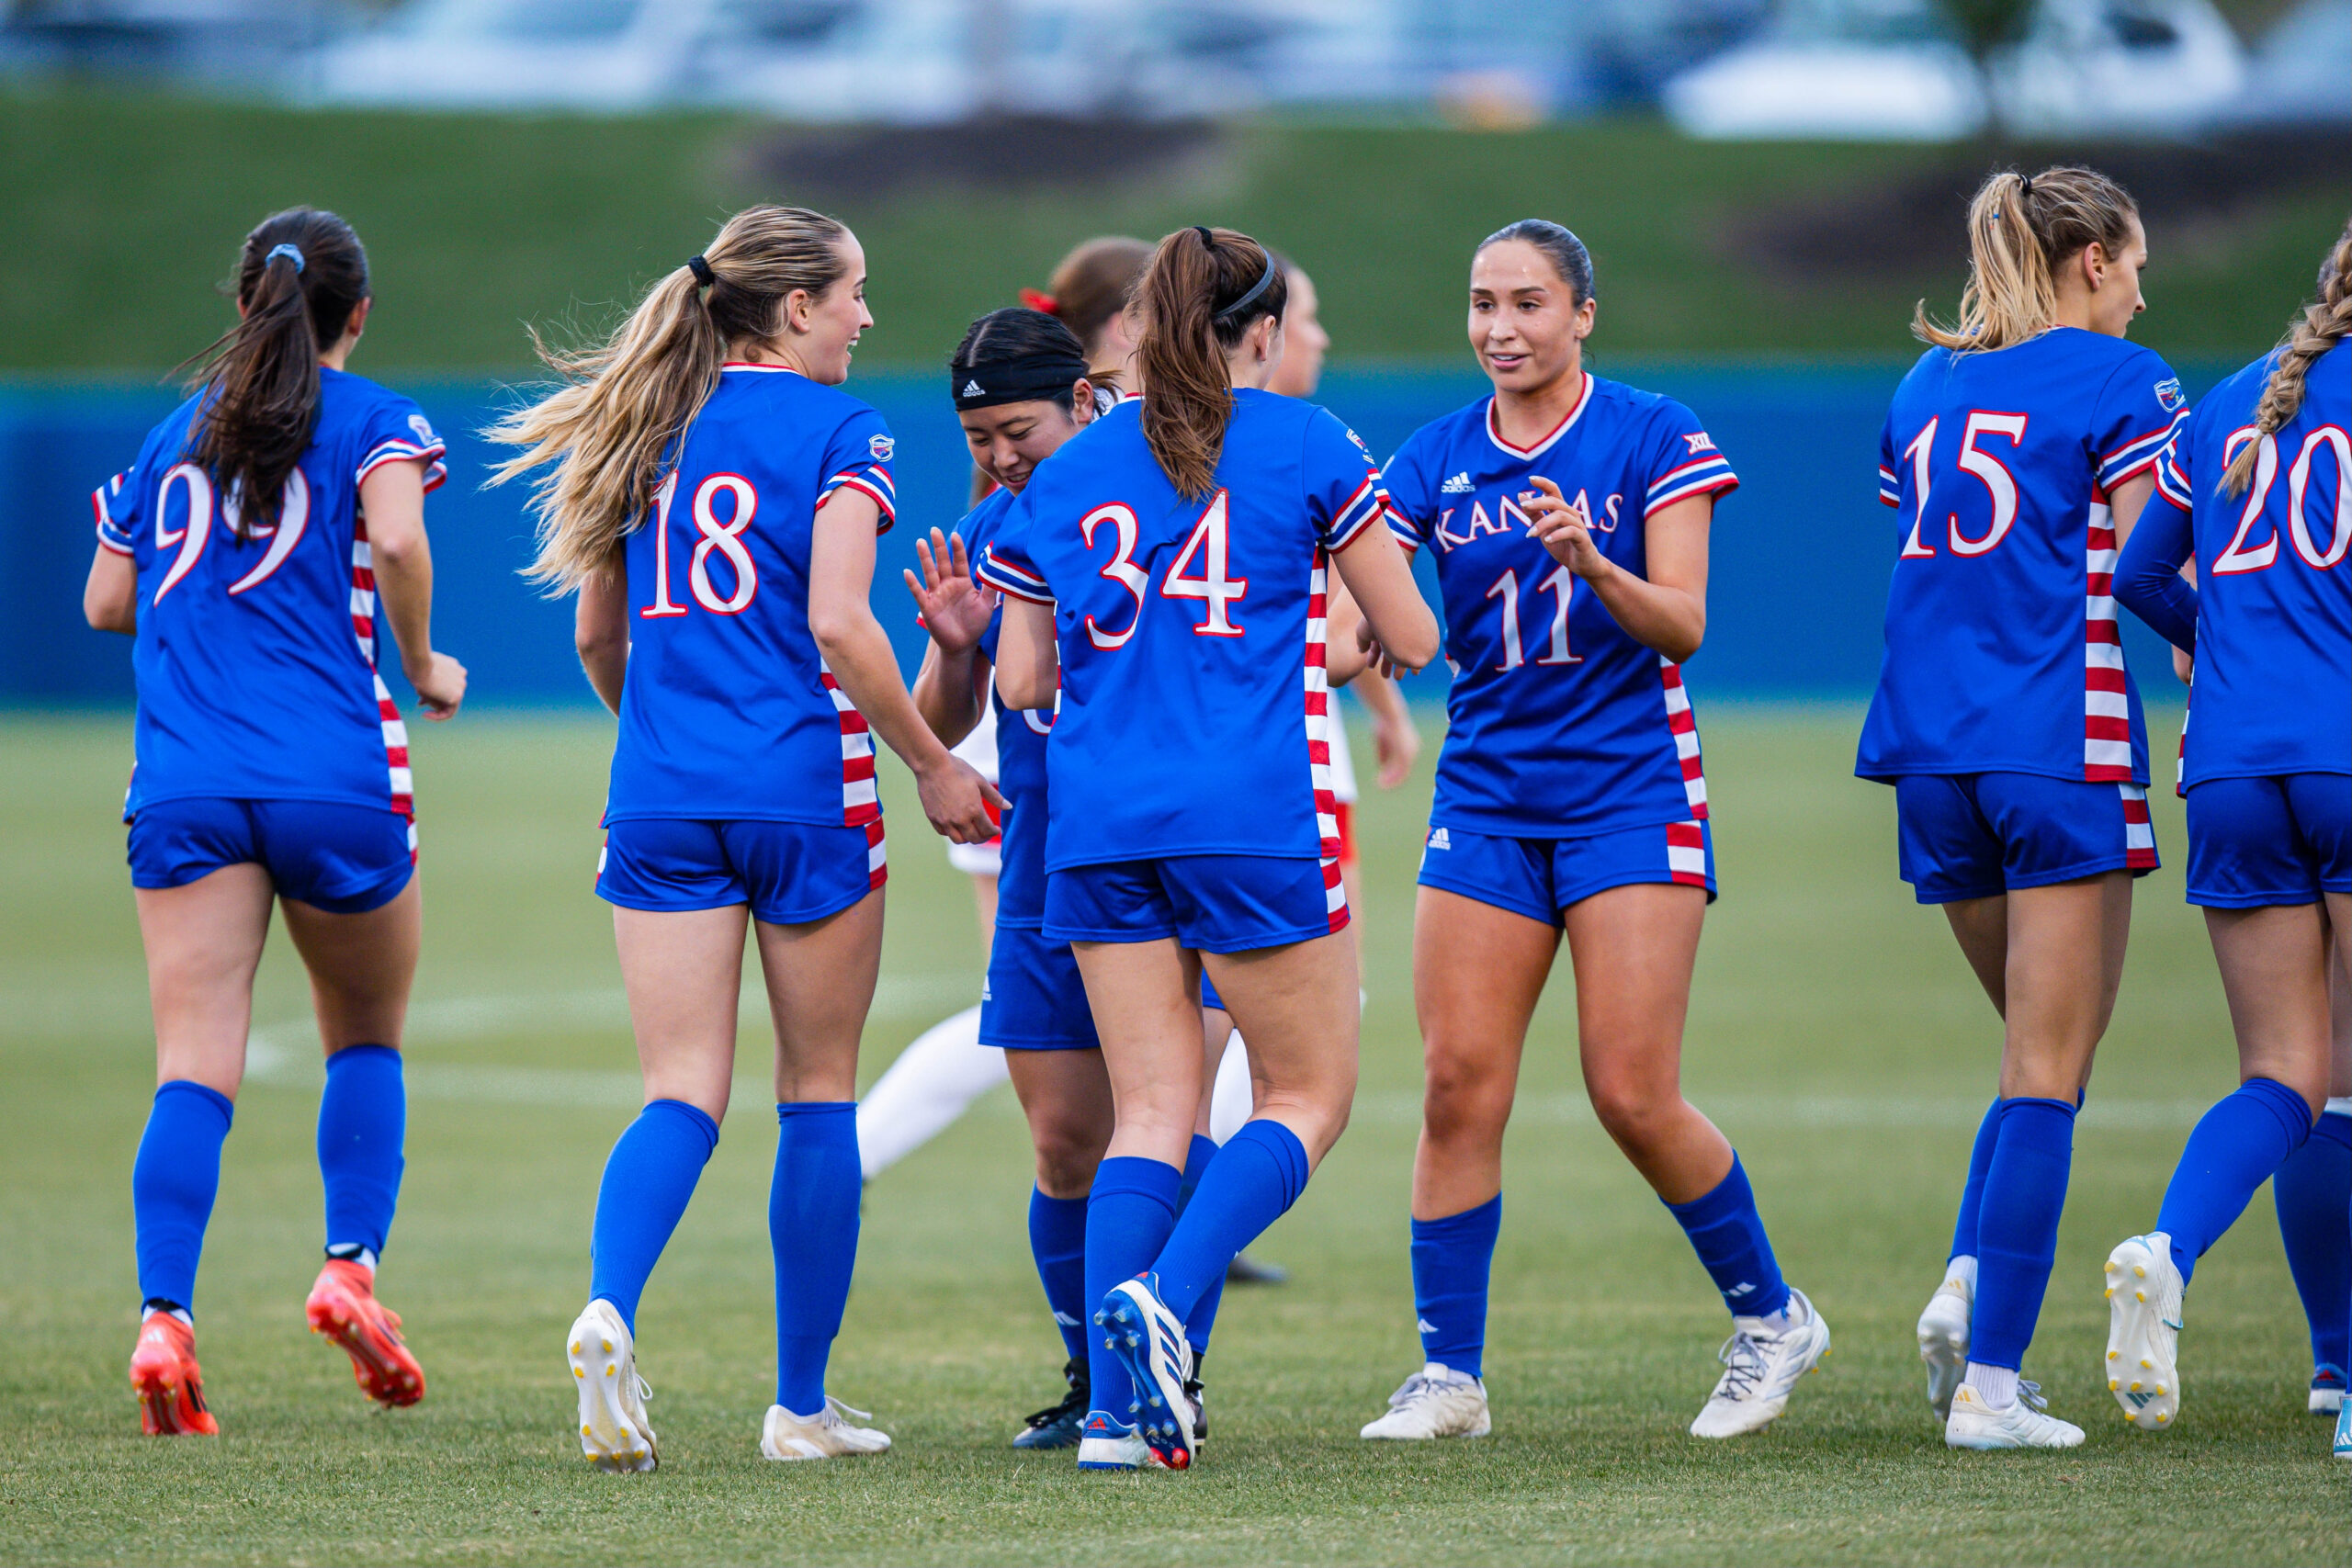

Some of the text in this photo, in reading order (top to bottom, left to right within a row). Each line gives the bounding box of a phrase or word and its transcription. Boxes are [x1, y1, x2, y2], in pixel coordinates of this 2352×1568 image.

[154, 461, 311, 608] 99
[640, 469, 759, 619] 18
[1434, 488, 1624, 554] KANAS
[1441, 484, 1476, 494] adidas
[1900, 409, 2029, 560] 15
[2212, 423, 2352, 577] 20
[1079, 487, 1249, 651] 34
[1485, 564, 1585, 673] 11
